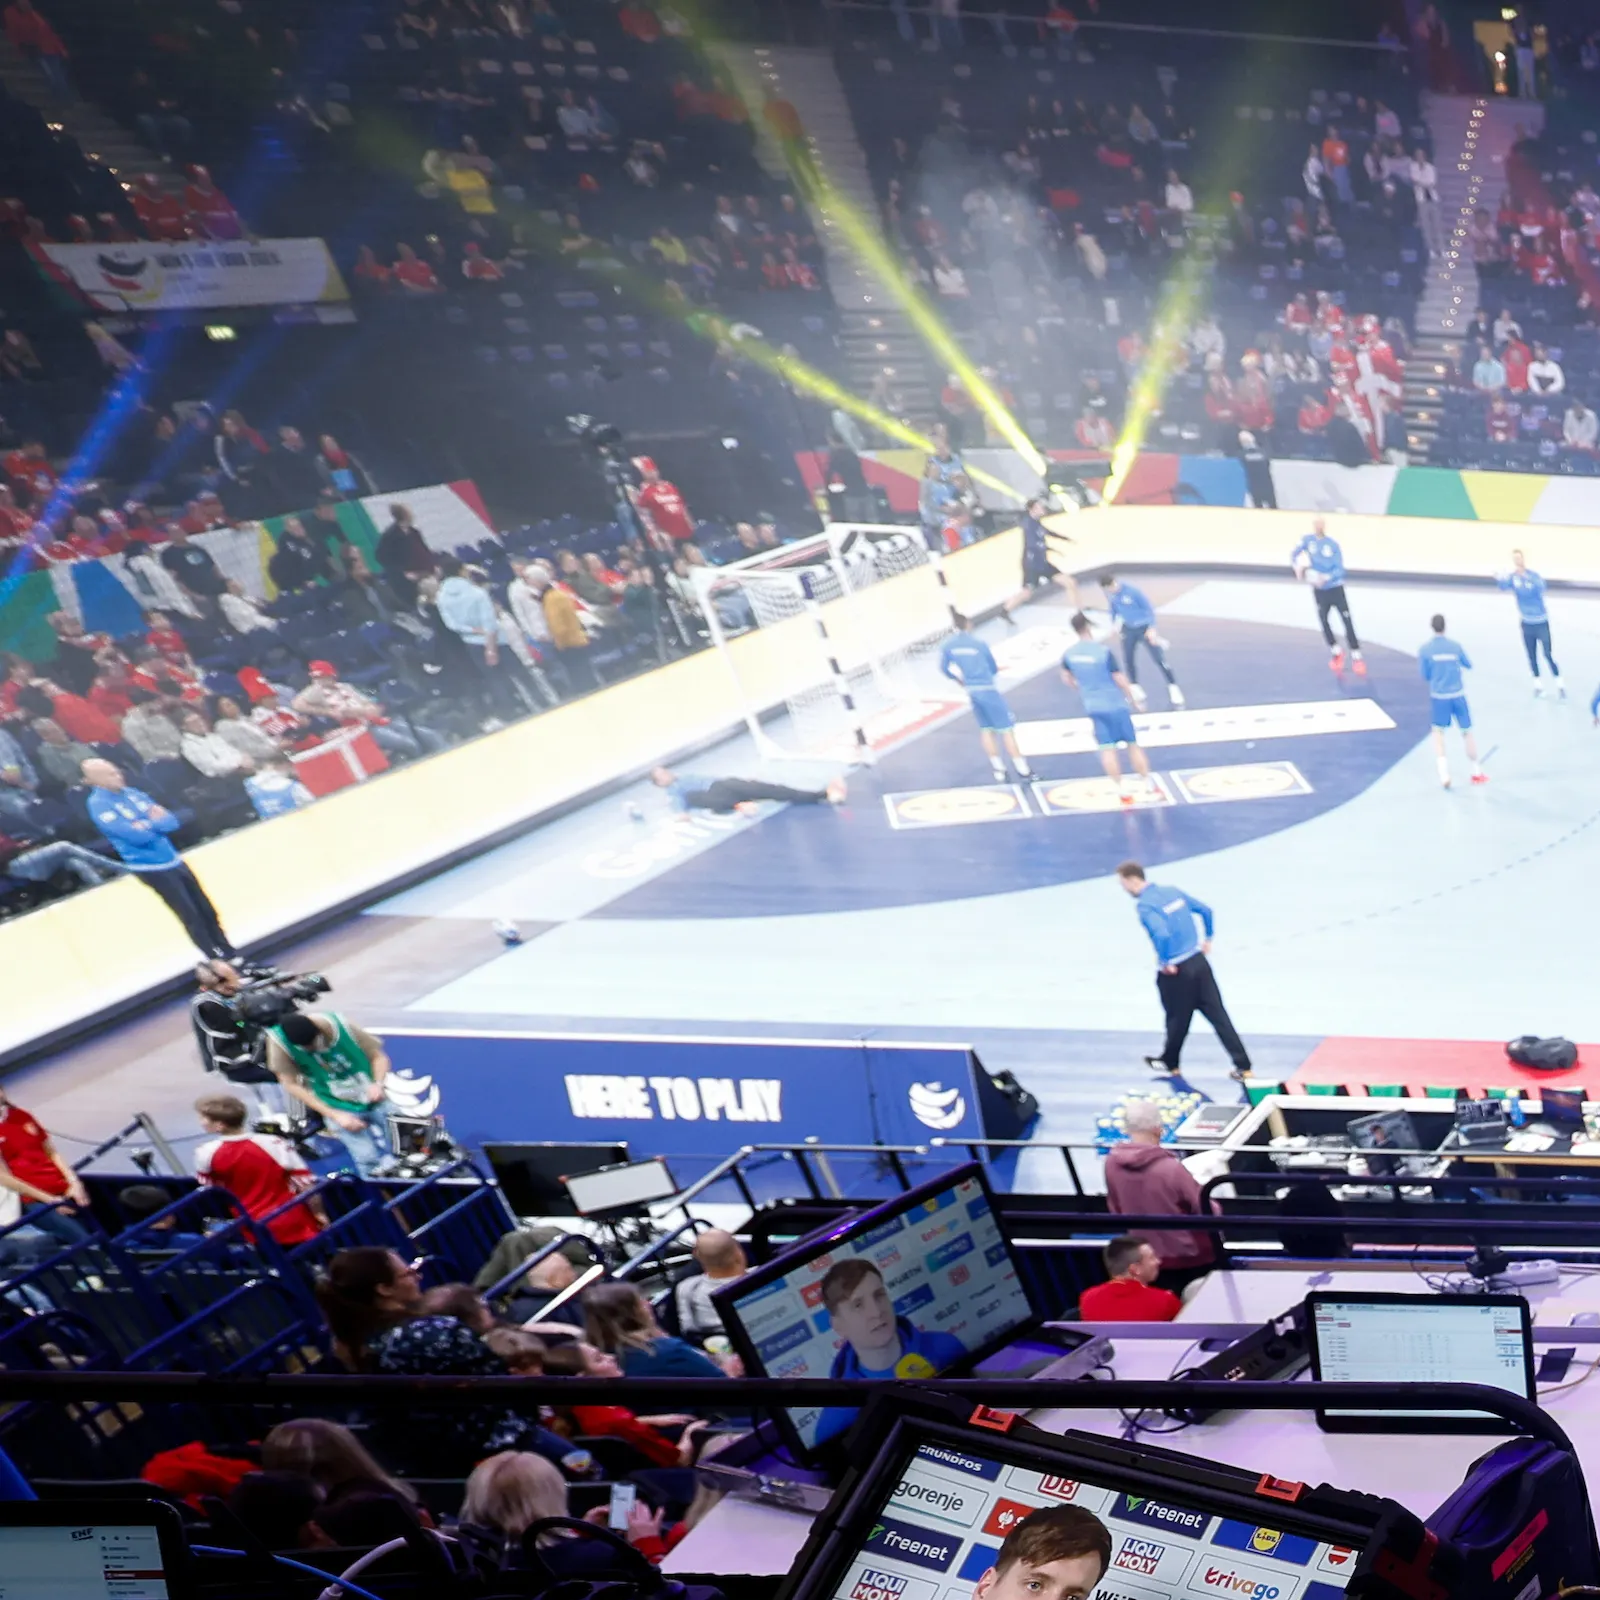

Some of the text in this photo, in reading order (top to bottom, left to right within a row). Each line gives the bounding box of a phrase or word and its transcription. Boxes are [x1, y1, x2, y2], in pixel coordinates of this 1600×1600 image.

[649, 1076, 700, 1121] TO
[698, 1078, 782, 1122] PLAY
[893, 1480, 964, 1511] gorenje
[1143, 1500, 1203, 1528] freenet
[883, 1530, 949, 1562] freenet
[1122, 1538, 1164, 1560] LIQUI
[1115, 1552, 1158, 1575] MOLY
[862, 1569, 908, 1592] LIQUI
